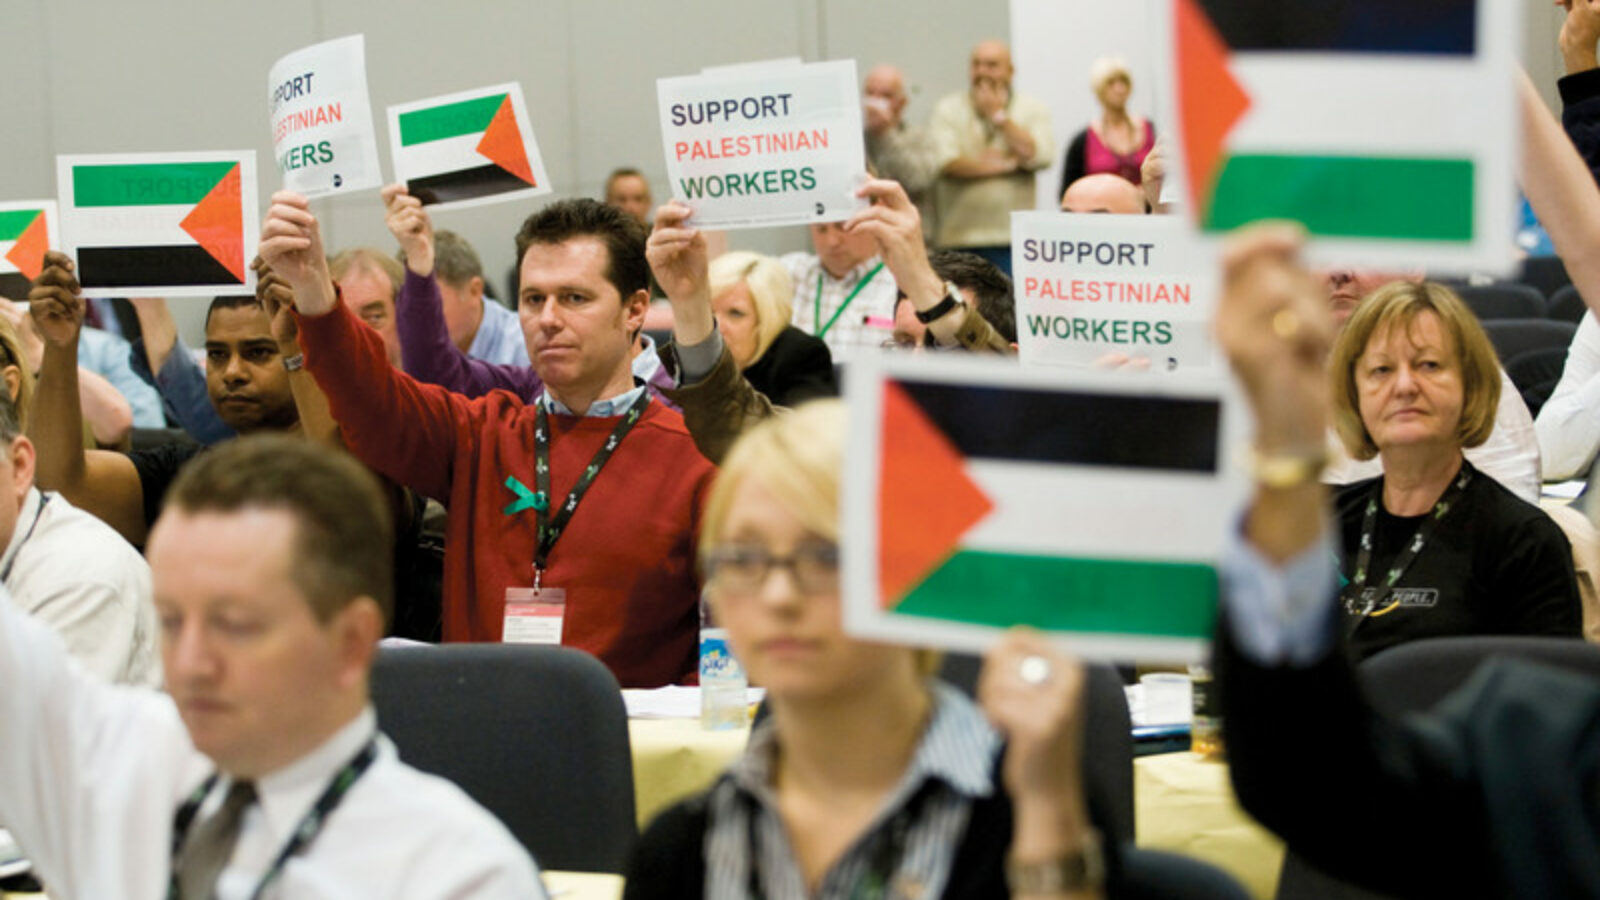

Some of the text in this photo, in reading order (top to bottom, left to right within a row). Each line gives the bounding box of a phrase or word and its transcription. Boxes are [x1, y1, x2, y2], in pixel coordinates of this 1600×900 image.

[671, 94, 792, 126] SUPPORT
[281, 141, 334, 172] KERS
[675, 128, 828, 161] PALESTINIAN
[680, 167, 817, 200] WORKERS
[1023, 239, 1154, 266] SUPPORT
[1024, 277, 1191, 304] PALESTINIAN
[1027, 314, 1173, 345] WORKERS
